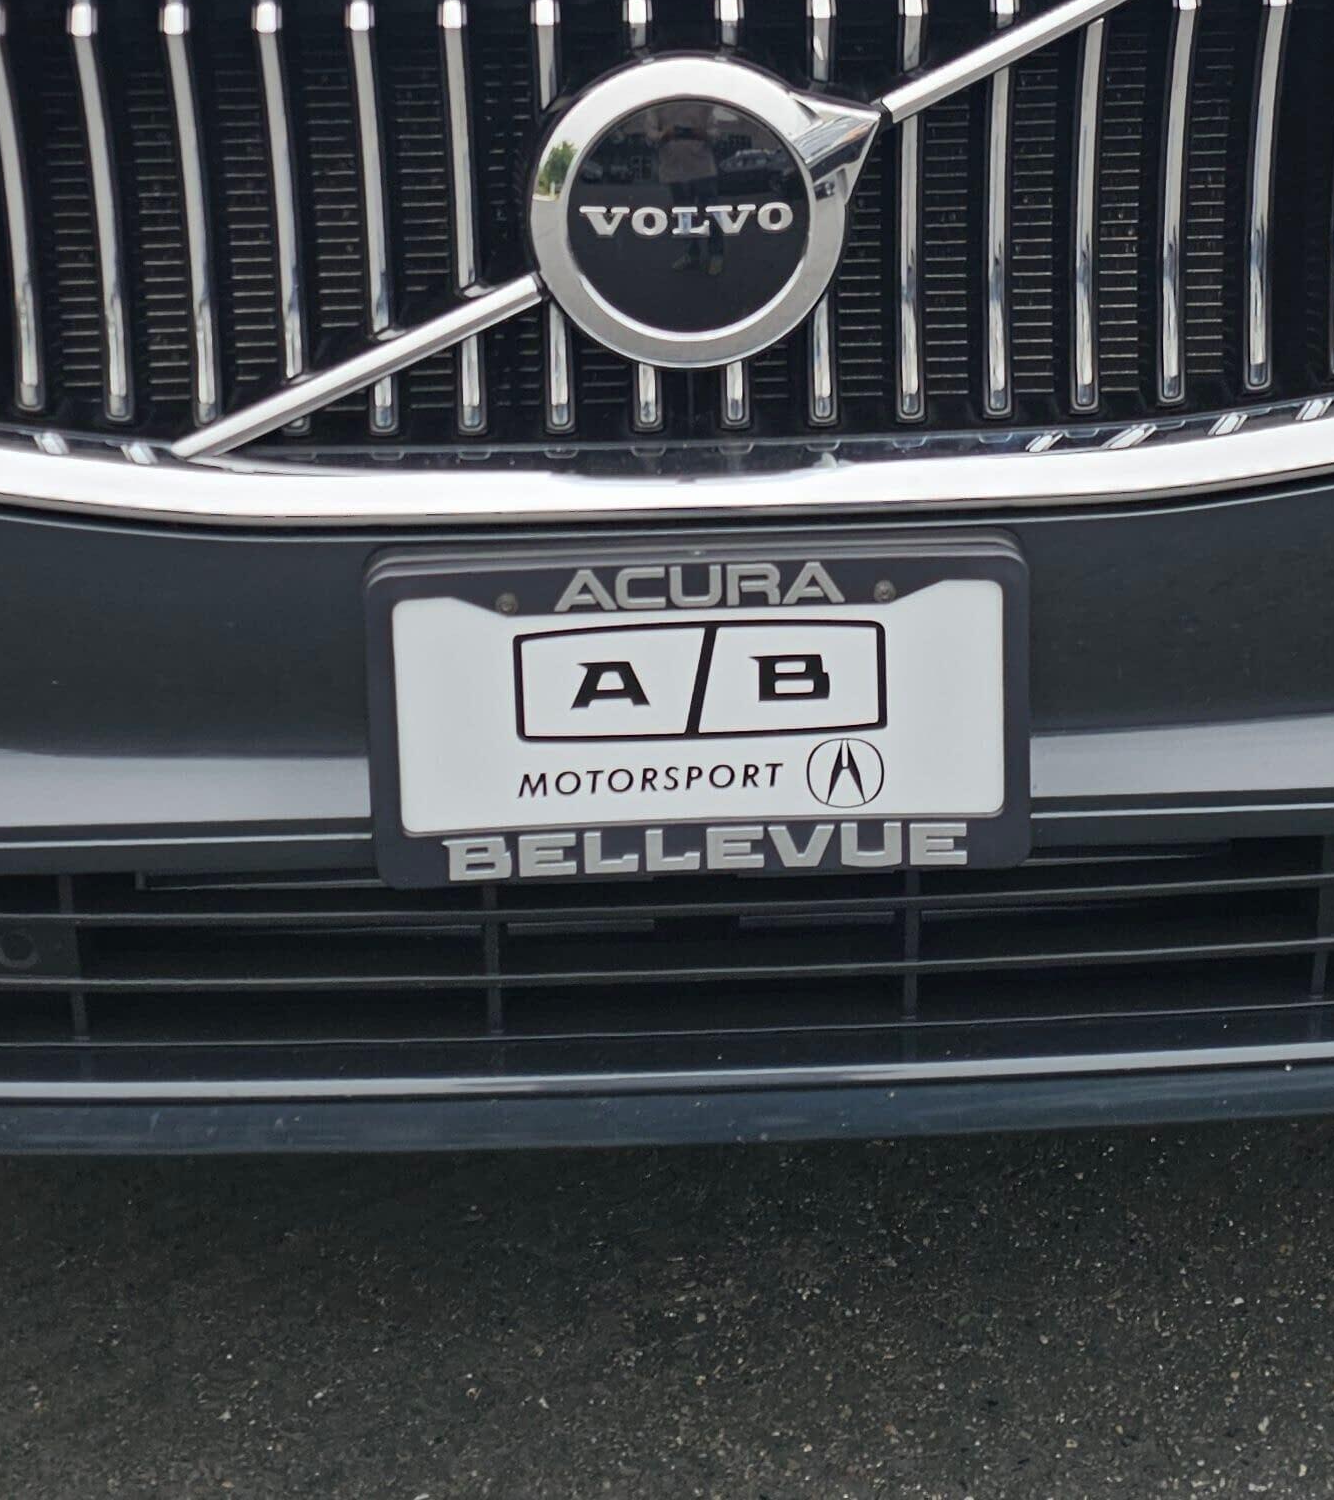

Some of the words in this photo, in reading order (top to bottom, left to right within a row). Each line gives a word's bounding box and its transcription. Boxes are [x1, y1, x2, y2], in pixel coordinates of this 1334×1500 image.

[579, 201, 794, 236] VOLVO
[553, 560, 846, 613] ACURA
[517, 761, 785, 799] MOTORSPORT
[441, 821, 969, 882] BELLEVUE
